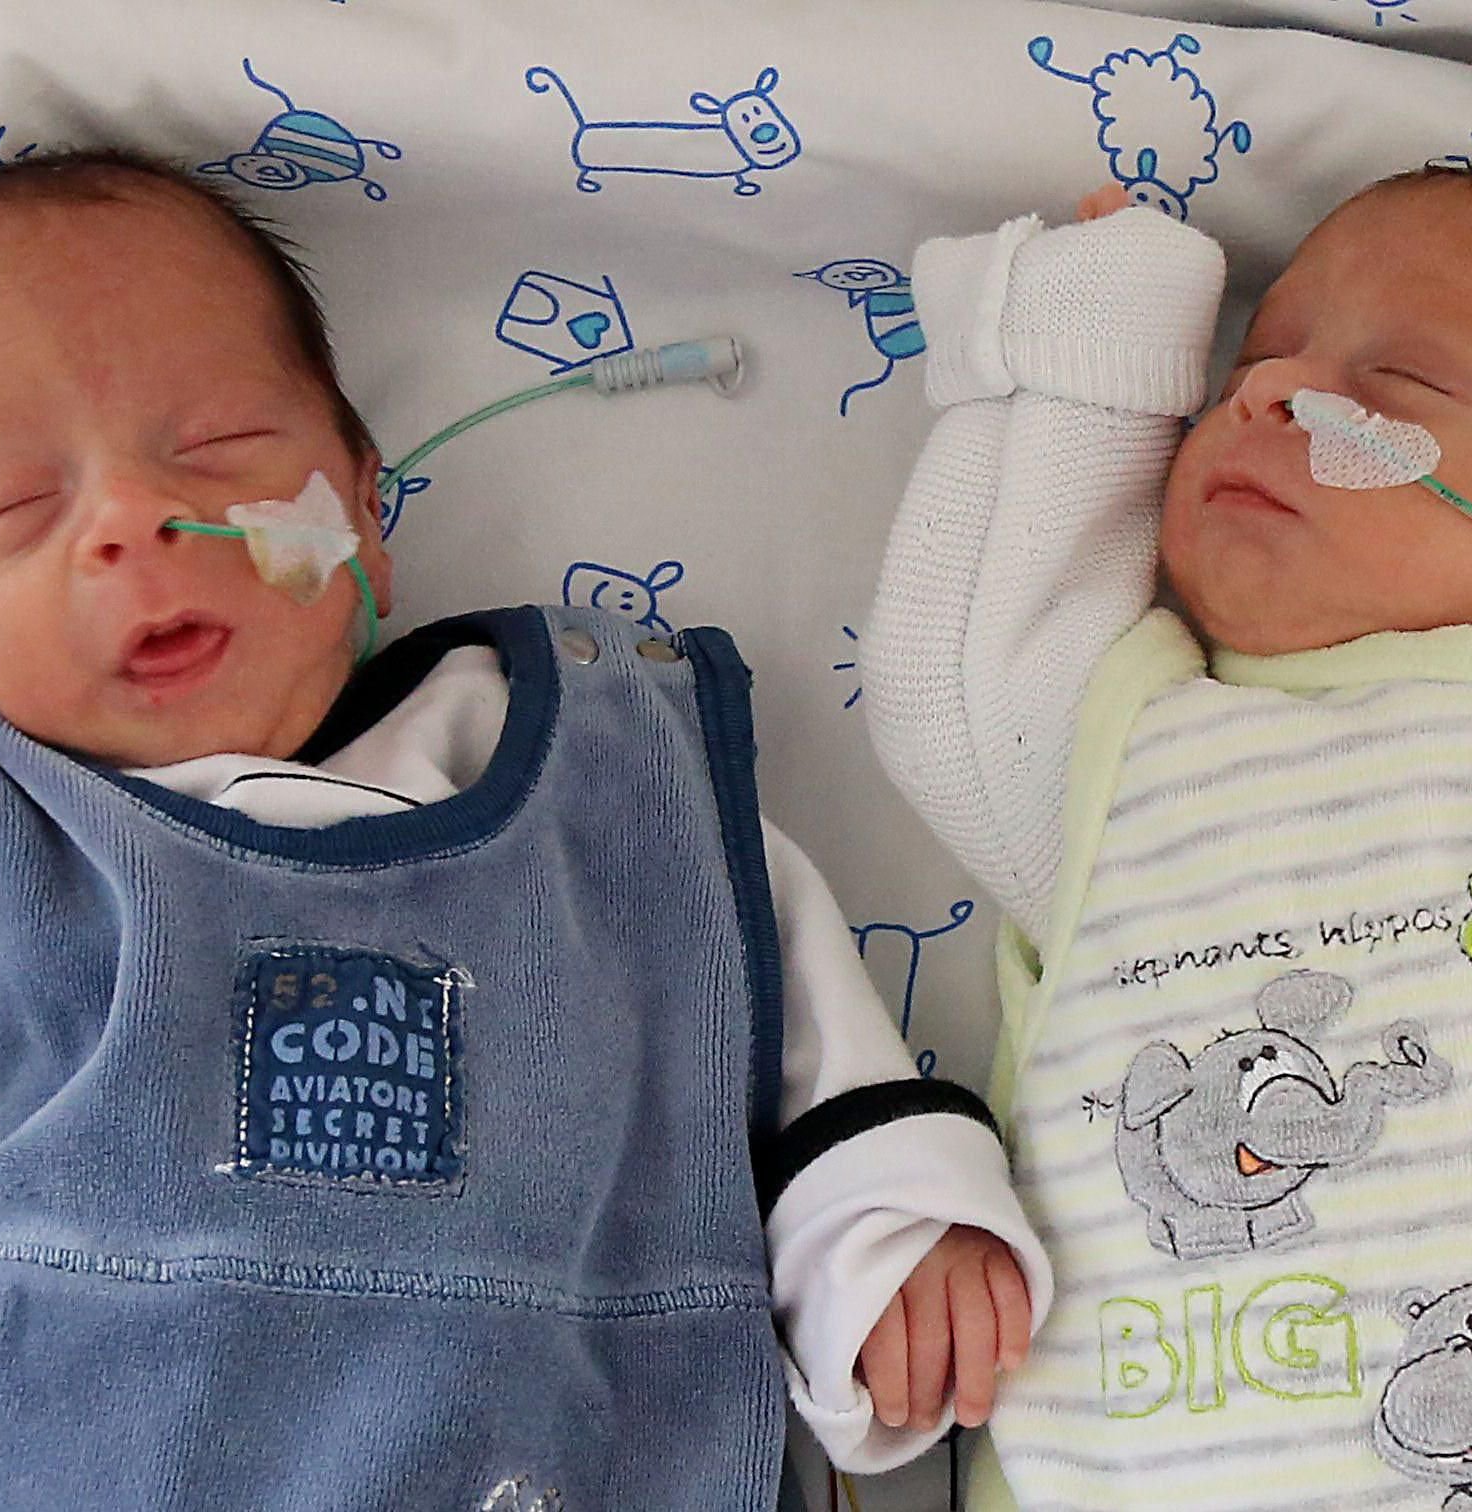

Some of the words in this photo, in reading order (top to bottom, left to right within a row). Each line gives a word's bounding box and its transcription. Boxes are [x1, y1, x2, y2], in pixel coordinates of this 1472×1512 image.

[270, 1018, 435, 1079] CODE
[269, 1075, 428, 1117] AVIATORS
[271, 1108, 429, 1145] SECRET
[269, 1137, 428, 1172] DIVISION
[1101, 1272, 1363, 1418] BIG
